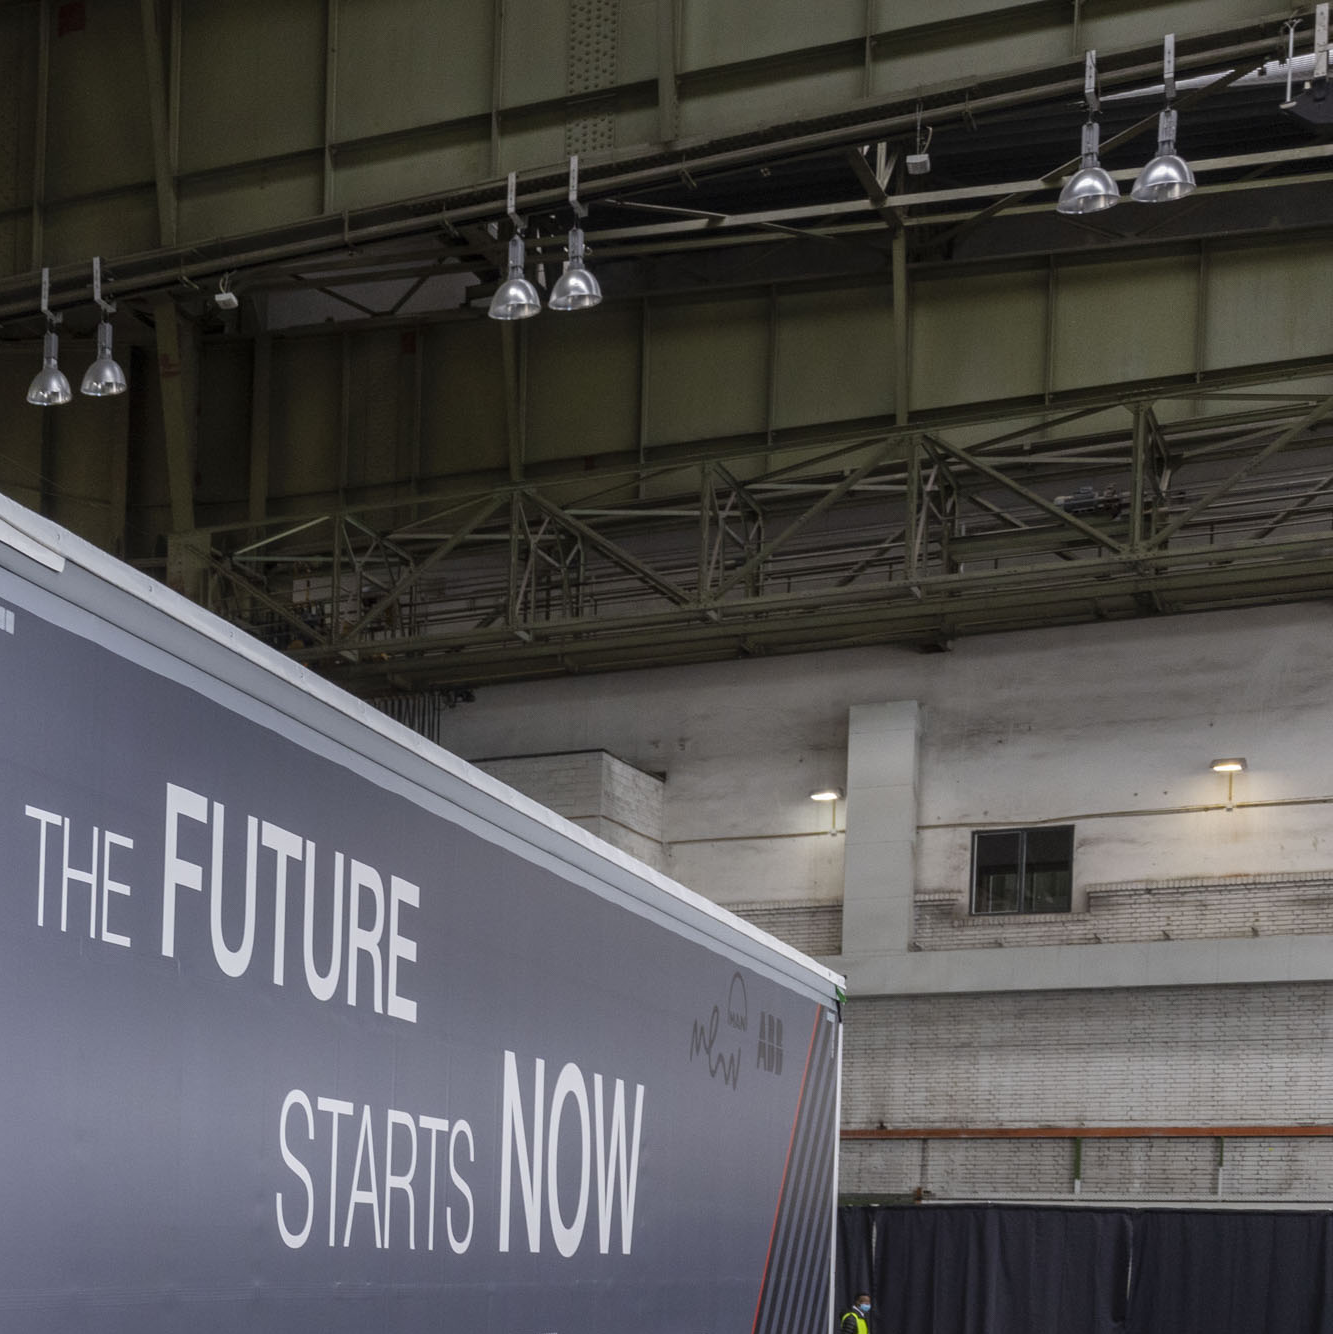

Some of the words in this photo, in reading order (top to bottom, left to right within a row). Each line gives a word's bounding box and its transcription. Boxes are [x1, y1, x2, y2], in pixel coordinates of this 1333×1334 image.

[25, 805, 134, 947] THE
[162, 782, 420, 1023] FUTURE
[756, 1010, 783, 1076] ABB
[276, 1089, 475, 1255] STARTS
[499, 1050, 645, 1258] NOW
